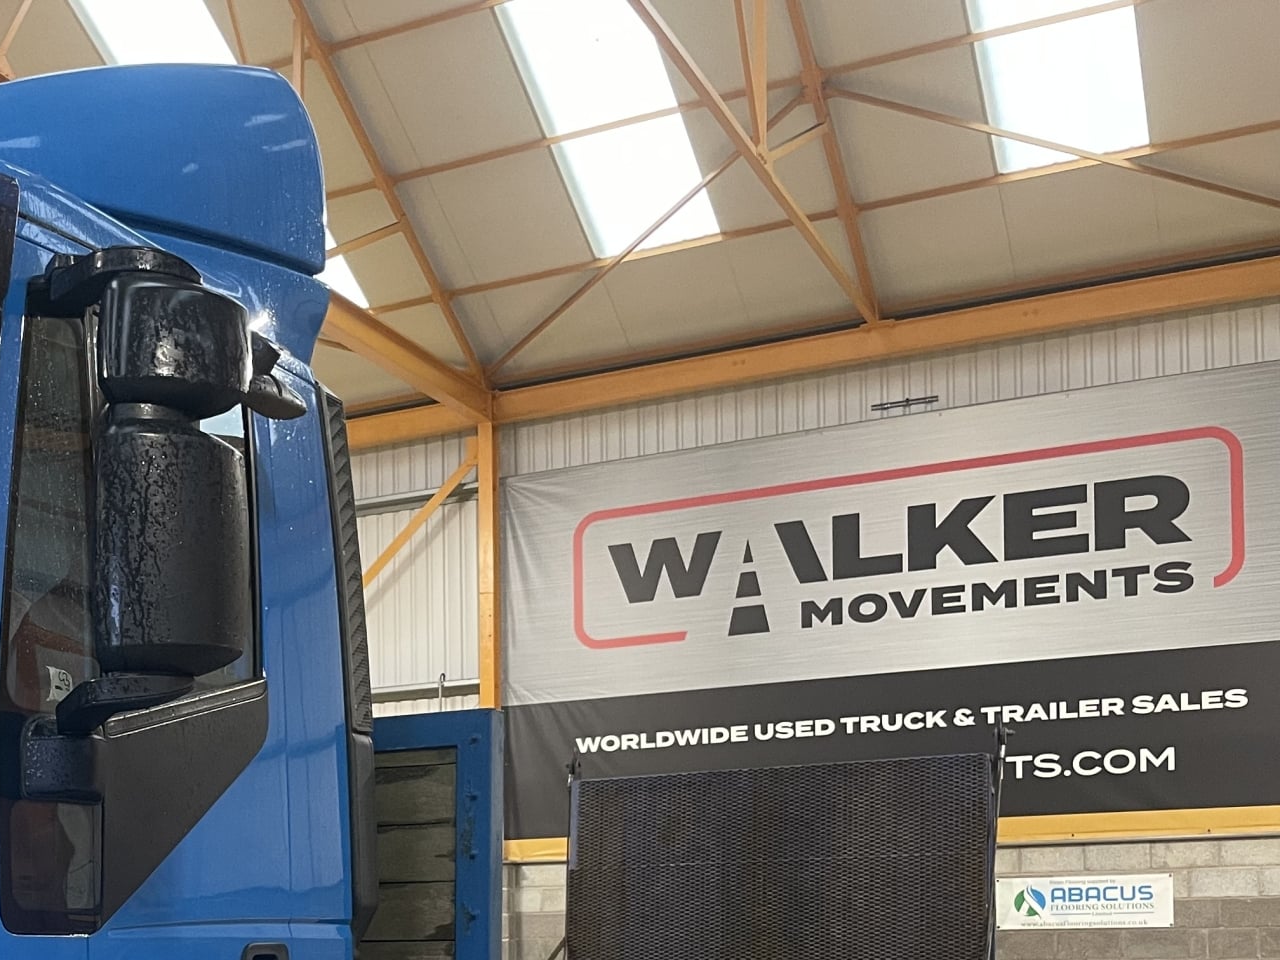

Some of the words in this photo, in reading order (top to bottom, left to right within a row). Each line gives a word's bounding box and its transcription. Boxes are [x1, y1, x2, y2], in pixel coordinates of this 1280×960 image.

[608, 474, 1192, 636] WALKER
[801, 560, 1195, 629] MOVEMENTS
[576, 725, 749, 753] WORLDWIDE
[754, 719, 836, 740] USED
[840, 709, 948, 735] TRUCK
[953, 707, 976, 727] &
[980, 697, 1125, 725] TRAILER
[1131, 688, 1249, 715] SALES
[1050, 885, 1154, 903] ABACUS
[1050, 903, 1099, 912] FLOORING
[1100, 902, 1155, 911] SOLUTIONS
